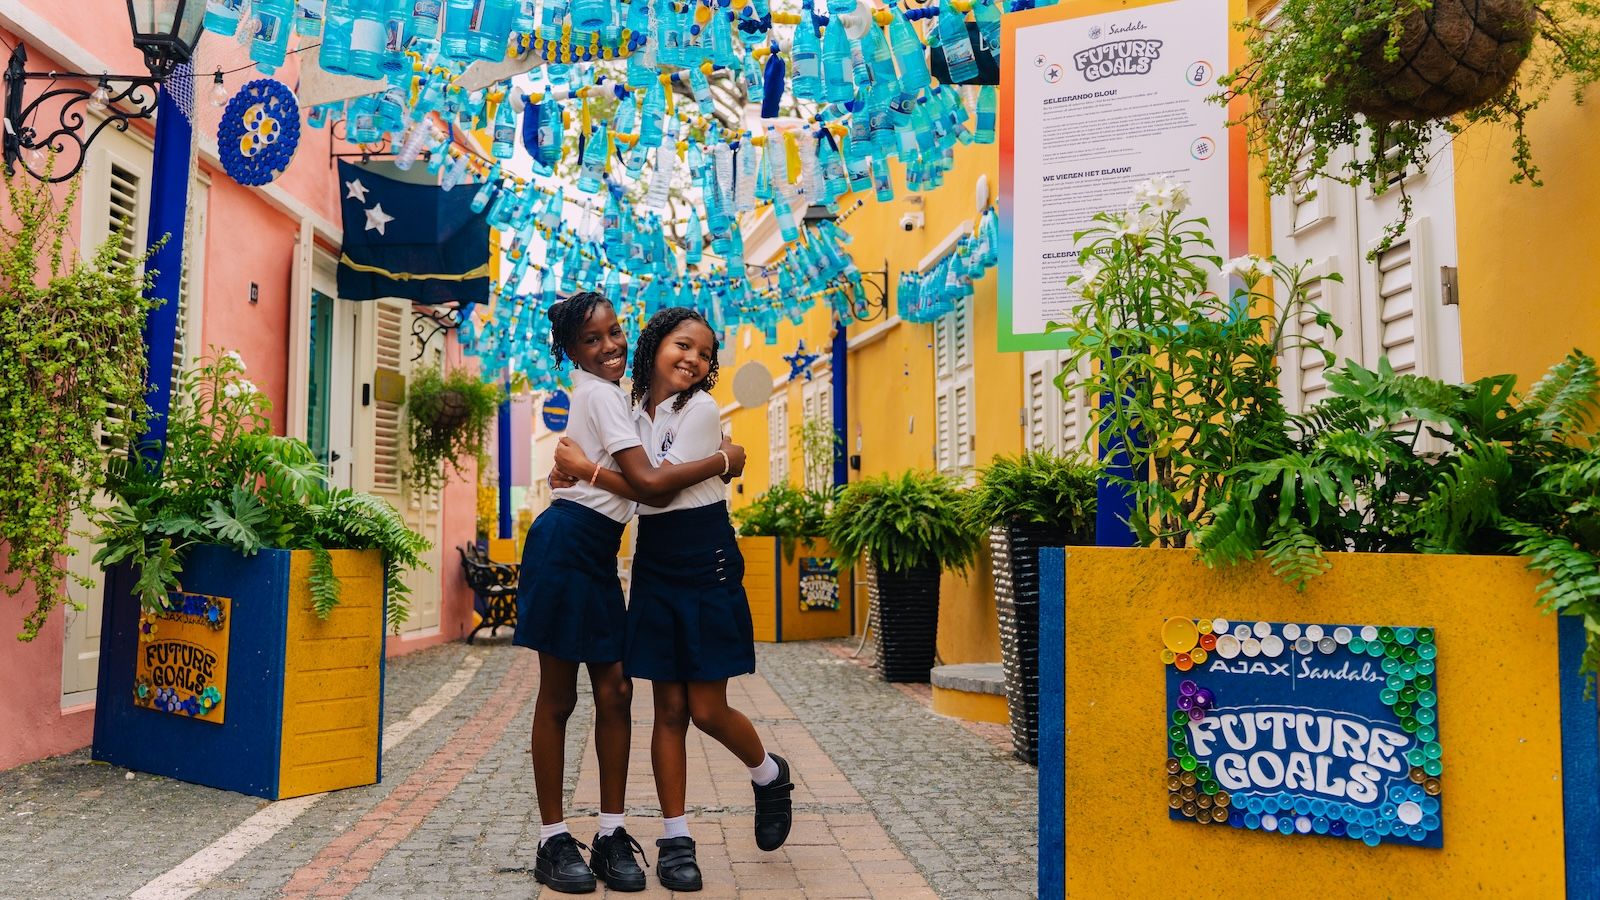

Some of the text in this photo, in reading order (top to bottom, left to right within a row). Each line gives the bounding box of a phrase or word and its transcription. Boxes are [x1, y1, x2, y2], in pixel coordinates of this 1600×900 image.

[1108, 21, 1148, 35] Sandals
[1074, 39, 1163, 71] FUTURE
[1084, 56, 1151, 81] GOALS
[1043, 92, 1094, 105] SELEBRANDO
[1056, 172, 1084, 180] VIEREN
[1101, 166, 1132, 175] BLAUW!
[145, 643, 217, 678] FUTURE
[1208, 657, 1386, 683] AJAX Sandals
[152, 665, 206, 696] GOALS
[1187, 711, 1410, 773] FUTURE
[1214, 751, 1382, 803] GOALS
